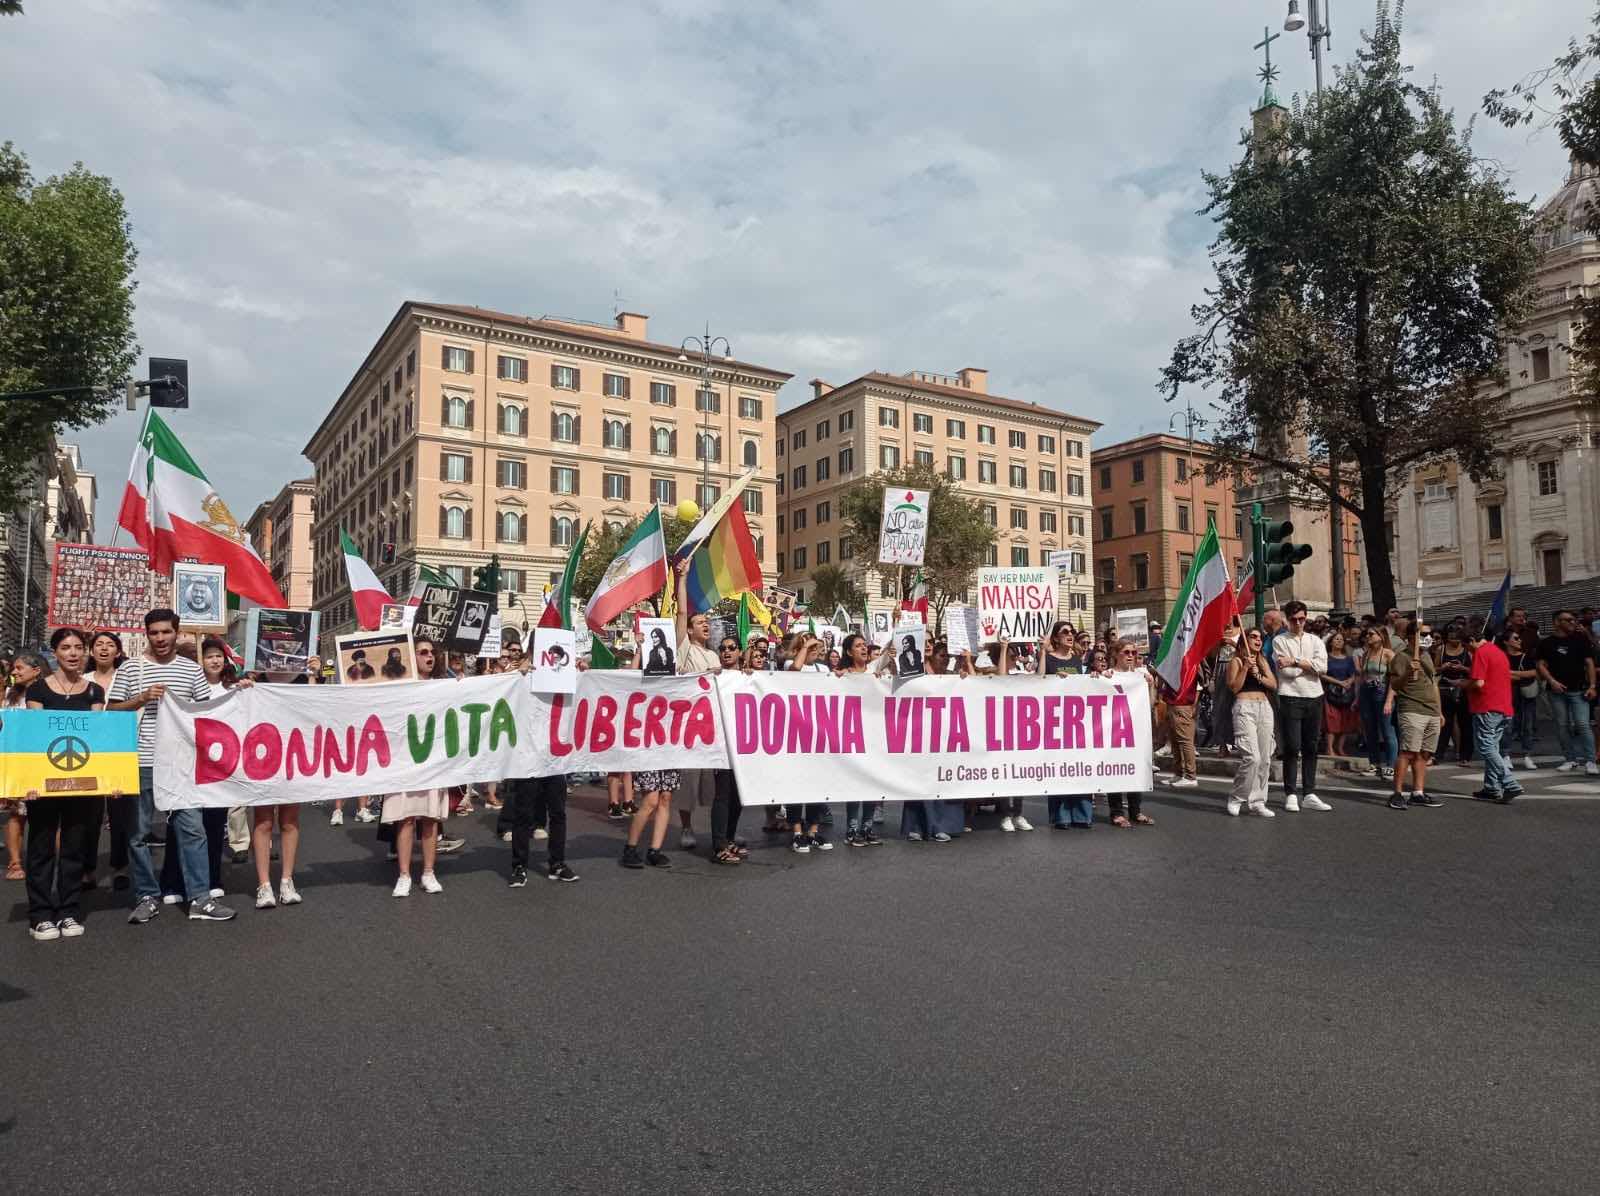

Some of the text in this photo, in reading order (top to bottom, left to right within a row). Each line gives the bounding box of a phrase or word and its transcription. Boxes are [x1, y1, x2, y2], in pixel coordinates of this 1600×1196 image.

[887, 511, 907, 529] NO
[60, 547, 90, 556] FLIGHT
[119, 552, 149, 561] INNOC
[983, 573, 1043, 583] SAY HER NAME
[982, 585, 1053, 610] MAHSA
[48, 716, 89, 731] PEACE
[734, 684, 1136, 755] DONNA VITA LIBERTÀ
[194, 714, 391, 785] DONNA
[407, 698, 518, 764] VITA
[937, 766, 953, 782] Le
[956, 765, 988, 781] Case
[991, 767, 999, 780] e
[1011, 762, 1056, 781] Luoghi
[1059, 761, 1093, 777] delle
[1096, 761, 1136, 776] donne
